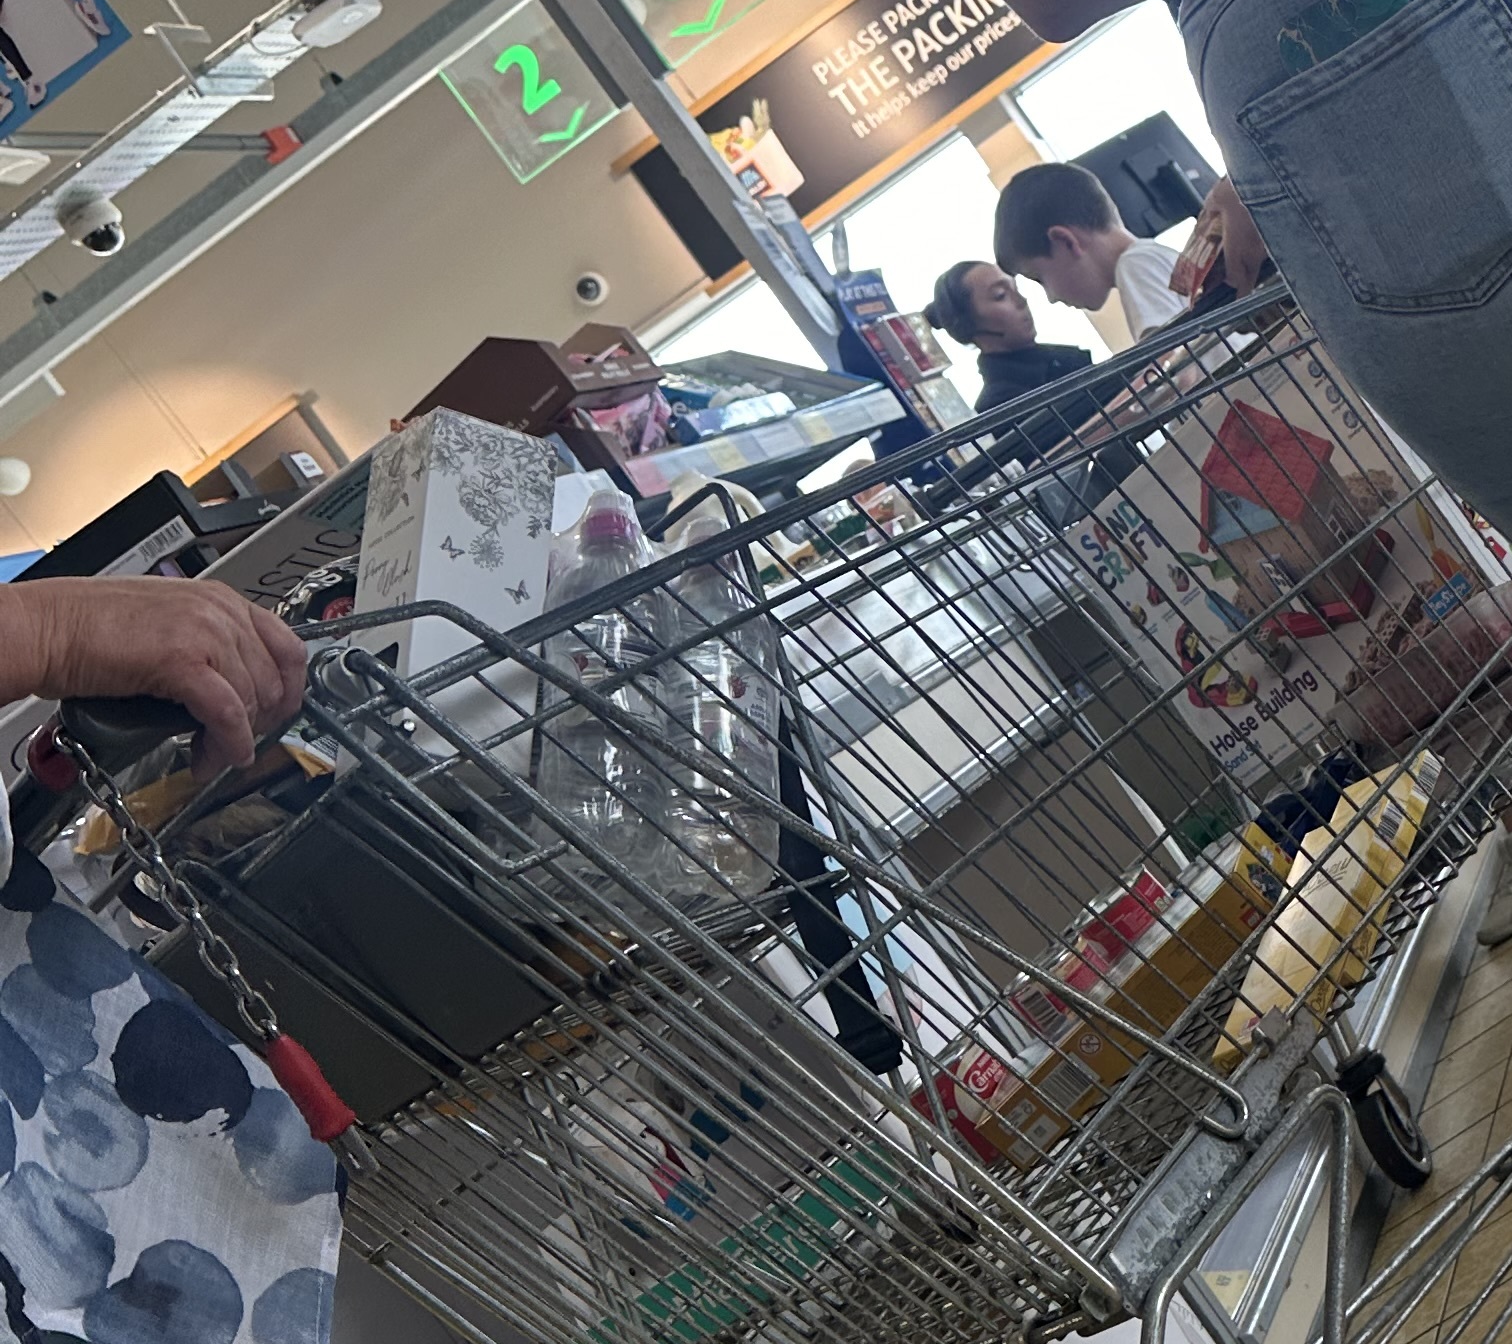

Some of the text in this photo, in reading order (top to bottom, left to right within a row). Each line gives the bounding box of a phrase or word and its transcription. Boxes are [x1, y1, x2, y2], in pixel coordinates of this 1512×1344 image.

[493, 44, 562, 115] 2
[811, 20, 888, 86] PLEASE
[828, 54, 901, 118] THE
[864, 88, 914, 133] helps
[905, 60, 952, 102] keep
[943, 42, 979, 73] our
[1080, 499, 1141, 554] SAND
[1208, 714, 1261, 759] House
[1252, 665, 1321, 724] Buildng
